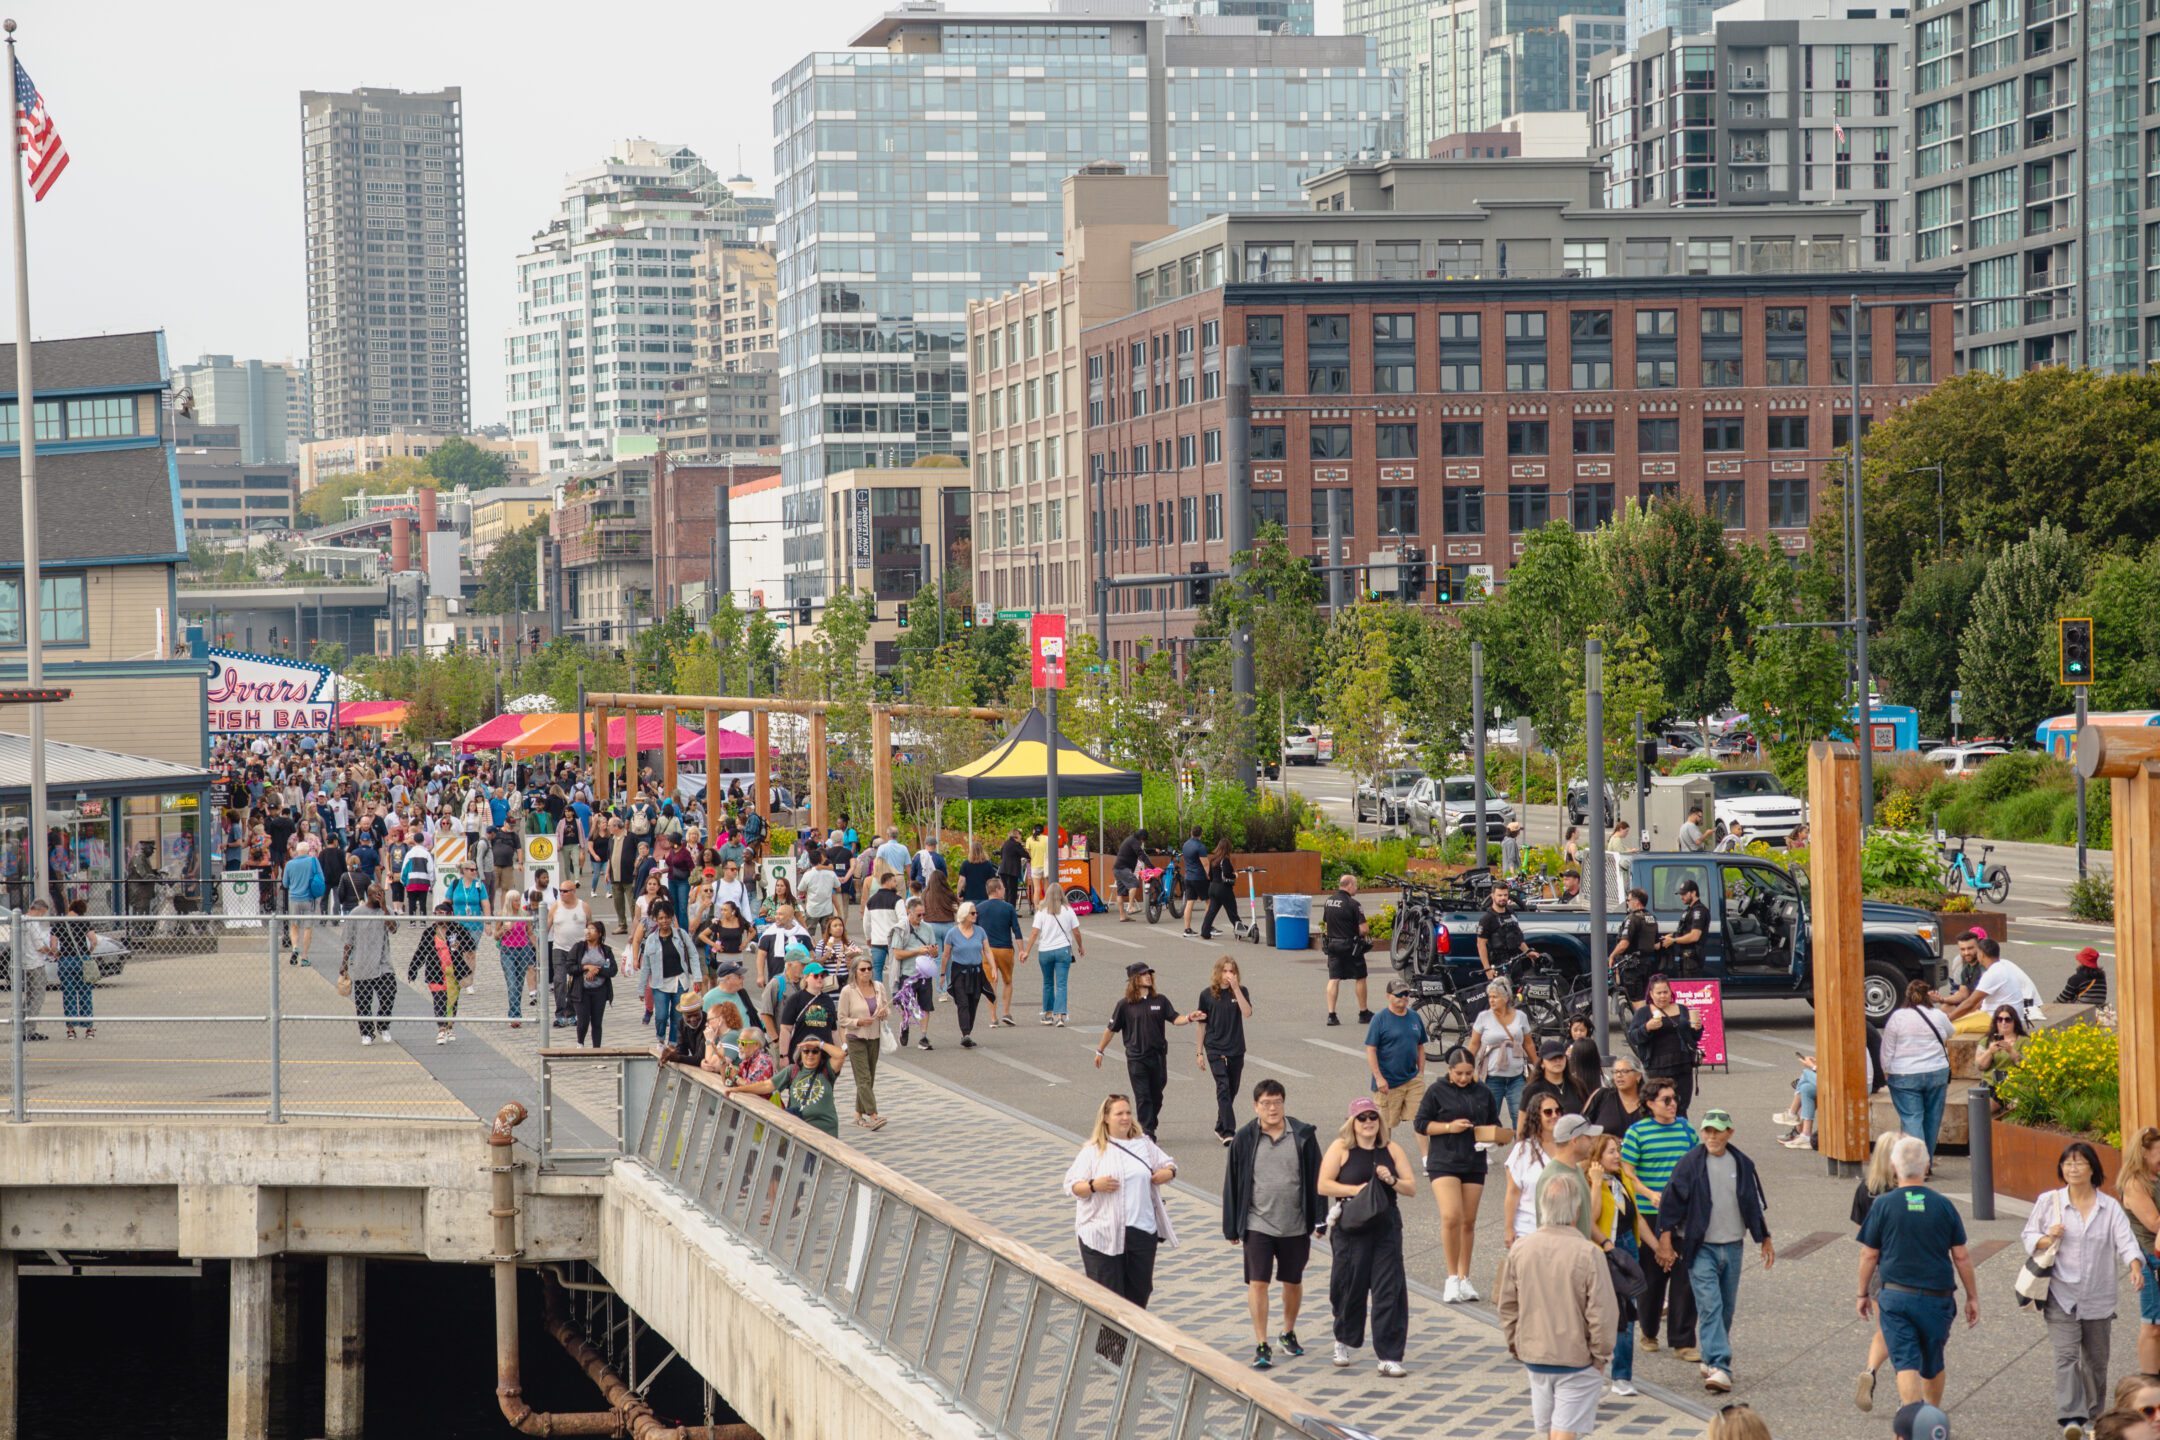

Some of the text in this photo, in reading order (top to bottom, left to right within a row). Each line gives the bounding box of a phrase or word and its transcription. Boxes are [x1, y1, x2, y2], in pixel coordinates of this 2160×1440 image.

[274, 709, 328, 729] BAR
[1326, 899, 1343, 908] POLICE
[1466, 992, 1487, 1004] POLICE
[1676, 991, 1693, 999] Thank
